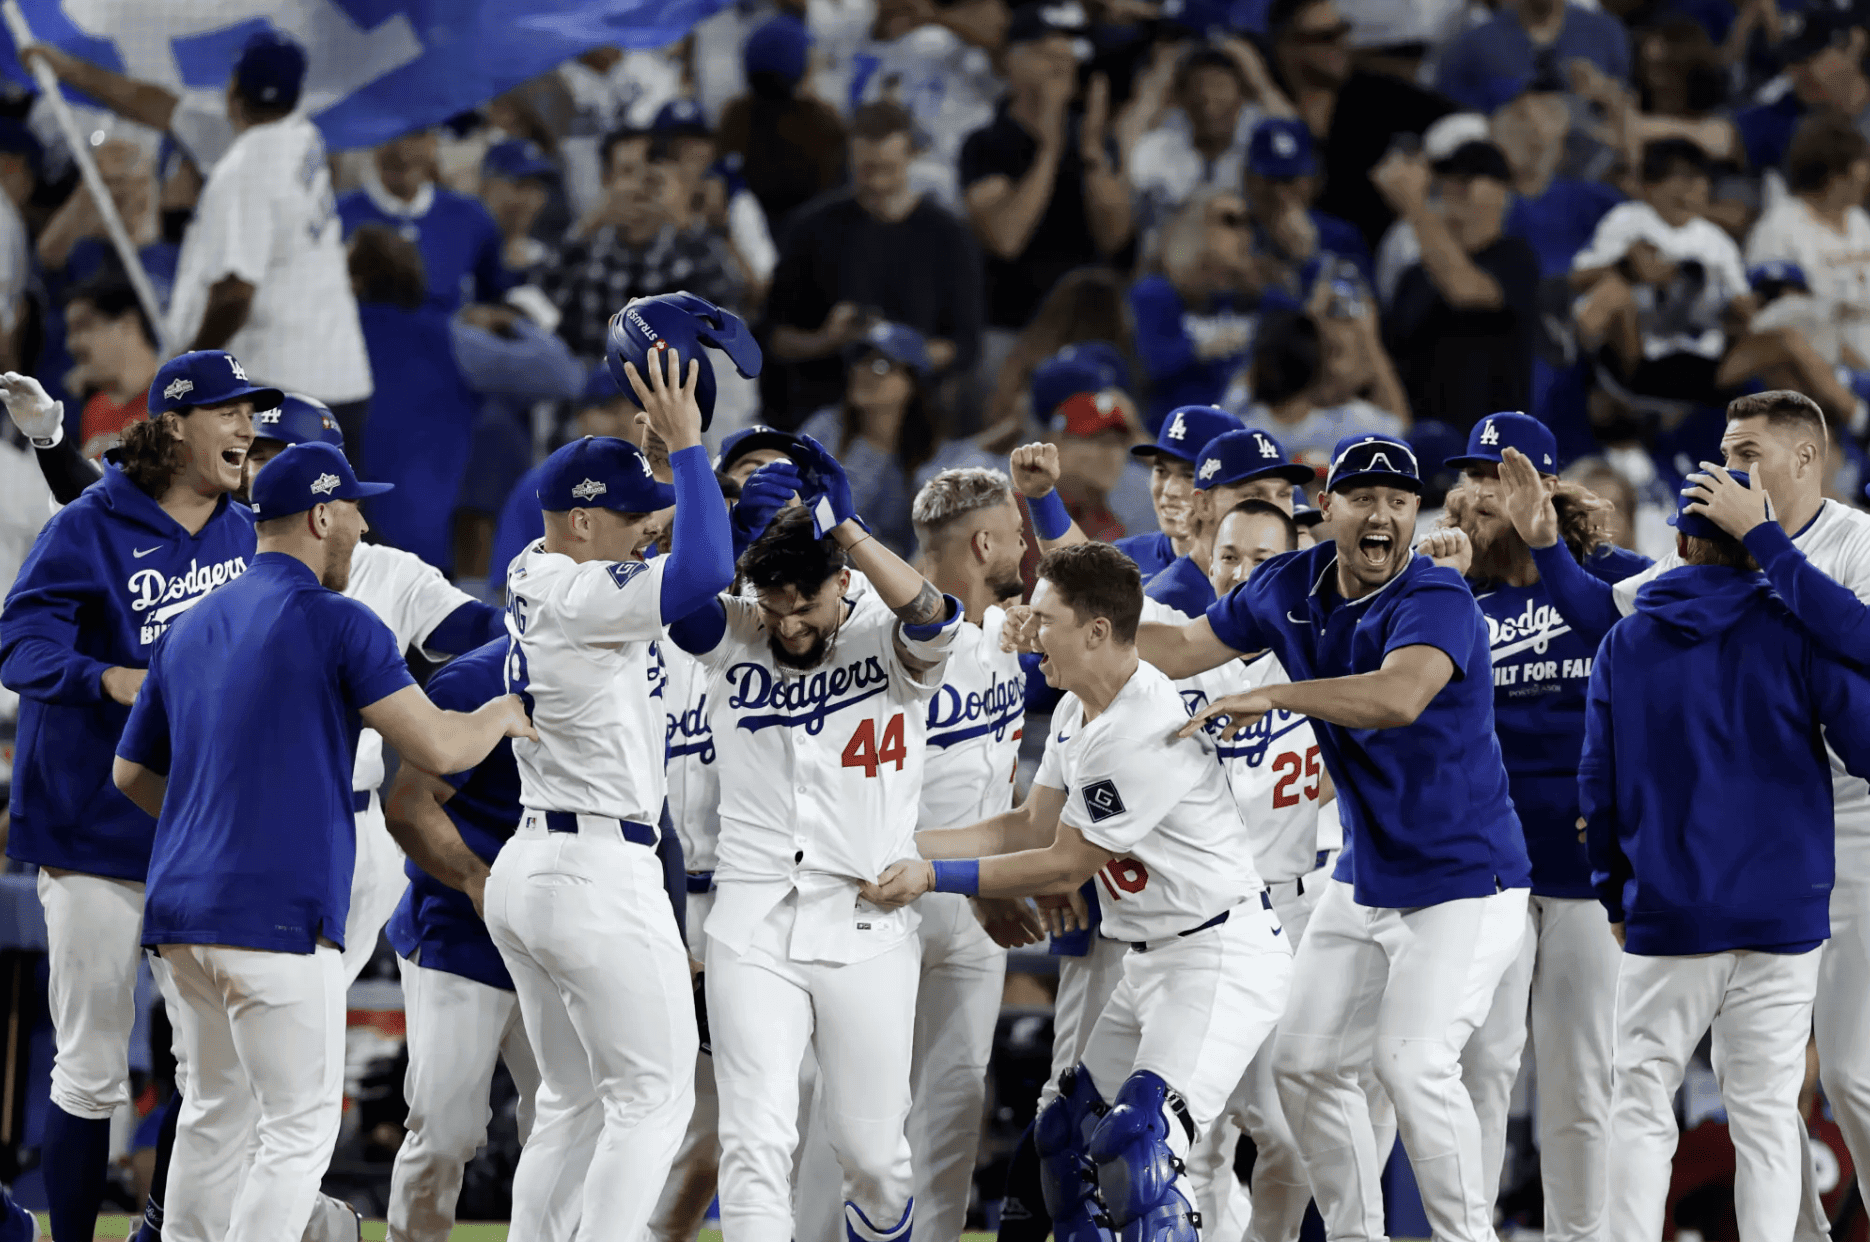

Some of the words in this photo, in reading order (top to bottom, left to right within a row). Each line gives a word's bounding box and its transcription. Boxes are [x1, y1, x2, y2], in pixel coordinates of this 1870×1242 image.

[627, 309, 658, 341] STRAUSS
[224, 355, 249, 381] LA
[1168, 412, 1187, 440] LA
[1480, 418, 1499, 445] LA
[1253, 433, 1280, 458] LA
[633, 451, 653, 478] LA
[1492, 664, 1519, 687] ILT
[1523, 660, 1558, 683] FOR
[1562, 657, 1592, 679] FAL
[725, 655, 889, 736] Dodgers
[841, 712, 907, 778] 44
[1271, 744, 1321, 810] 25
[1094, 788, 1114, 807] G
[1098, 857, 1150, 901] 16
